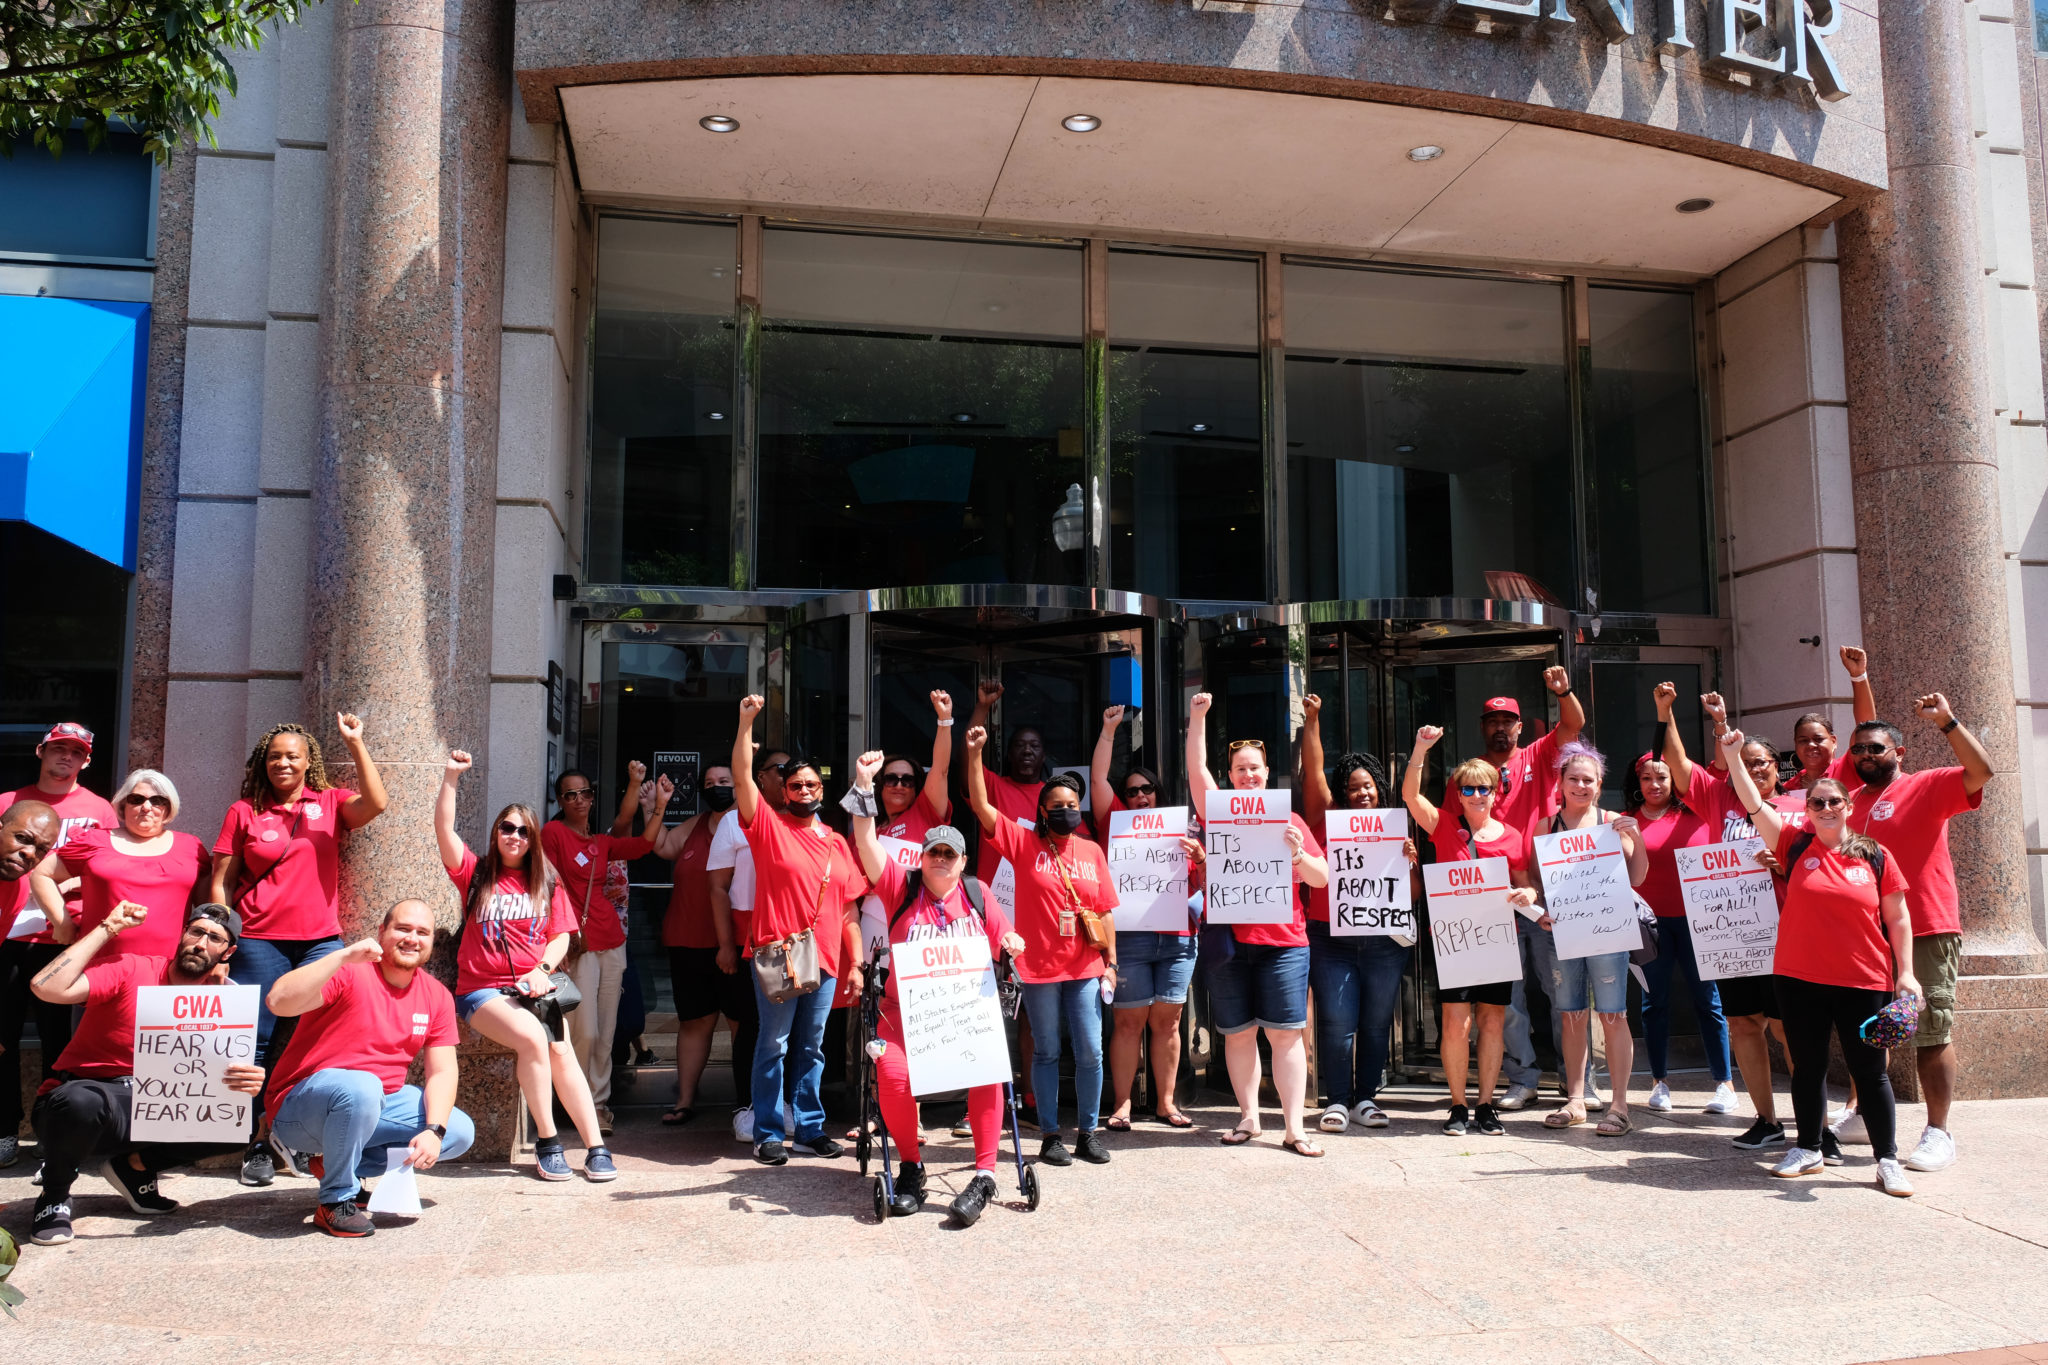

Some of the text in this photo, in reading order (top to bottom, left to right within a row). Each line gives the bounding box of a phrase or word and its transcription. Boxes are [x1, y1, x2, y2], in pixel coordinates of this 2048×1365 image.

[1230, 796, 1266, 815] CWA
[1132, 813, 1164, 830] CWA
[1349, 816, 1384, 833] CWA
[1208, 832, 1241, 855] IT'S
[1560, 833, 1597, 855] CWA
[898, 847, 922, 867] CW
[1145, 848, 1188, 864] ABOUT
[1222, 858, 1284, 875] ABOUT
[1333, 847, 1364, 872] It's
[1702, 848, 1742, 871] CWA
[1448, 866, 1485, 887] CWA
[1598, 875, 1617, 887] the
[1210, 882, 1289, 909] RESPECT
[1336, 877, 1399, 903] ABOUT
[1690, 879, 1773, 904] EQUAL RIGHTS
[1337, 903, 1412, 930] RESPECT
[1600, 906, 1614, 915] to
[1704, 904, 1724, 914] FOR
[1433, 918, 1516, 957] RESPECT!
[922, 945, 964, 967] CWA
[1722, 951, 1743, 960] ALL
[1745, 948, 1776, 959] ABOUT
[1713, 959, 1767, 973] RESPECT
[909, 986, 947, 1008] Let's
[953, 982, 967, 995] Be
[172, 995, 223, 1019] CWA
[908, 1013, 922, 1025] All
[924, 1007, 949, 1020] State
[907, 1029, 920, 1038] are
[949, 1013, 972, 1029] Treat
[138, 1033, 252, 1059] HEAR US
[173, 1059, 208, 1078] OR
[135, 1077, 217, 1099] YOU'LL
[134, 1102, 189, 1122] FEAR
[34, 1203, 71, 1222] adida
